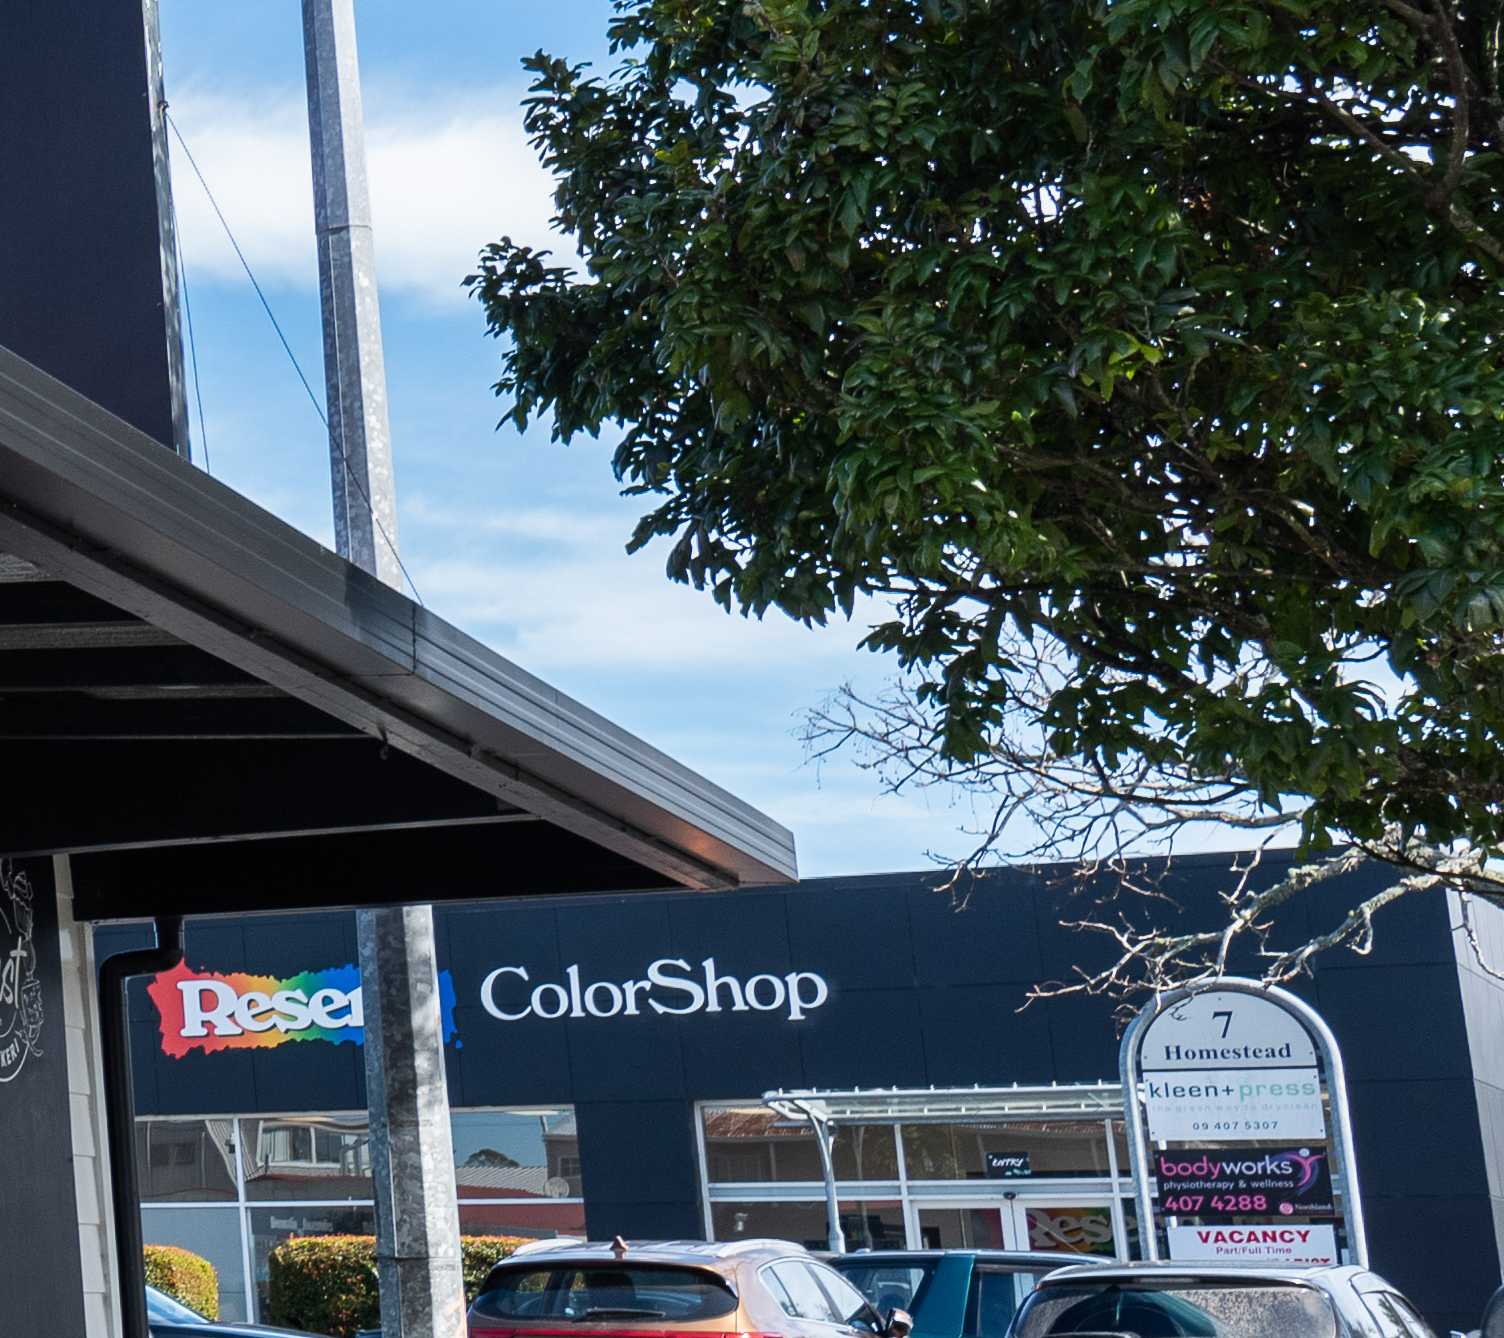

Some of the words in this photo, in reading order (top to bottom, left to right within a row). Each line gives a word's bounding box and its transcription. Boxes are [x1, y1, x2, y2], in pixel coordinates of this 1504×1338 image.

[176, 979, 364, 1037] Rese
[480, 958, 828, 1021] ColorShop
[1212, 1011, 1233, 1039] 7
[1164, 1043, 1291, 1061] Homestead
[1192, 1122, 1209, 1130] 09
[1214, 1121, 1238, 1130] 407
[1245, 1120, 1279, 1130] 5307
[1160, 1155, 1293, 1180] bodyworks
[1163, 1180, 1234, 1191] physiotherapy
[1238, 1180, 1246, 1188] &
[1250, 1179, 1294, 1188] wellness
[1165, 1195, 1204, 1211] 407
[1210, 1195, 1267, 1211] 4288
[1197, 1230, 1310, 1243] VACANCY
[1216, 1246, 1262, 1254] Part/Full
[1265, 1246, 1292, 1254] Time
